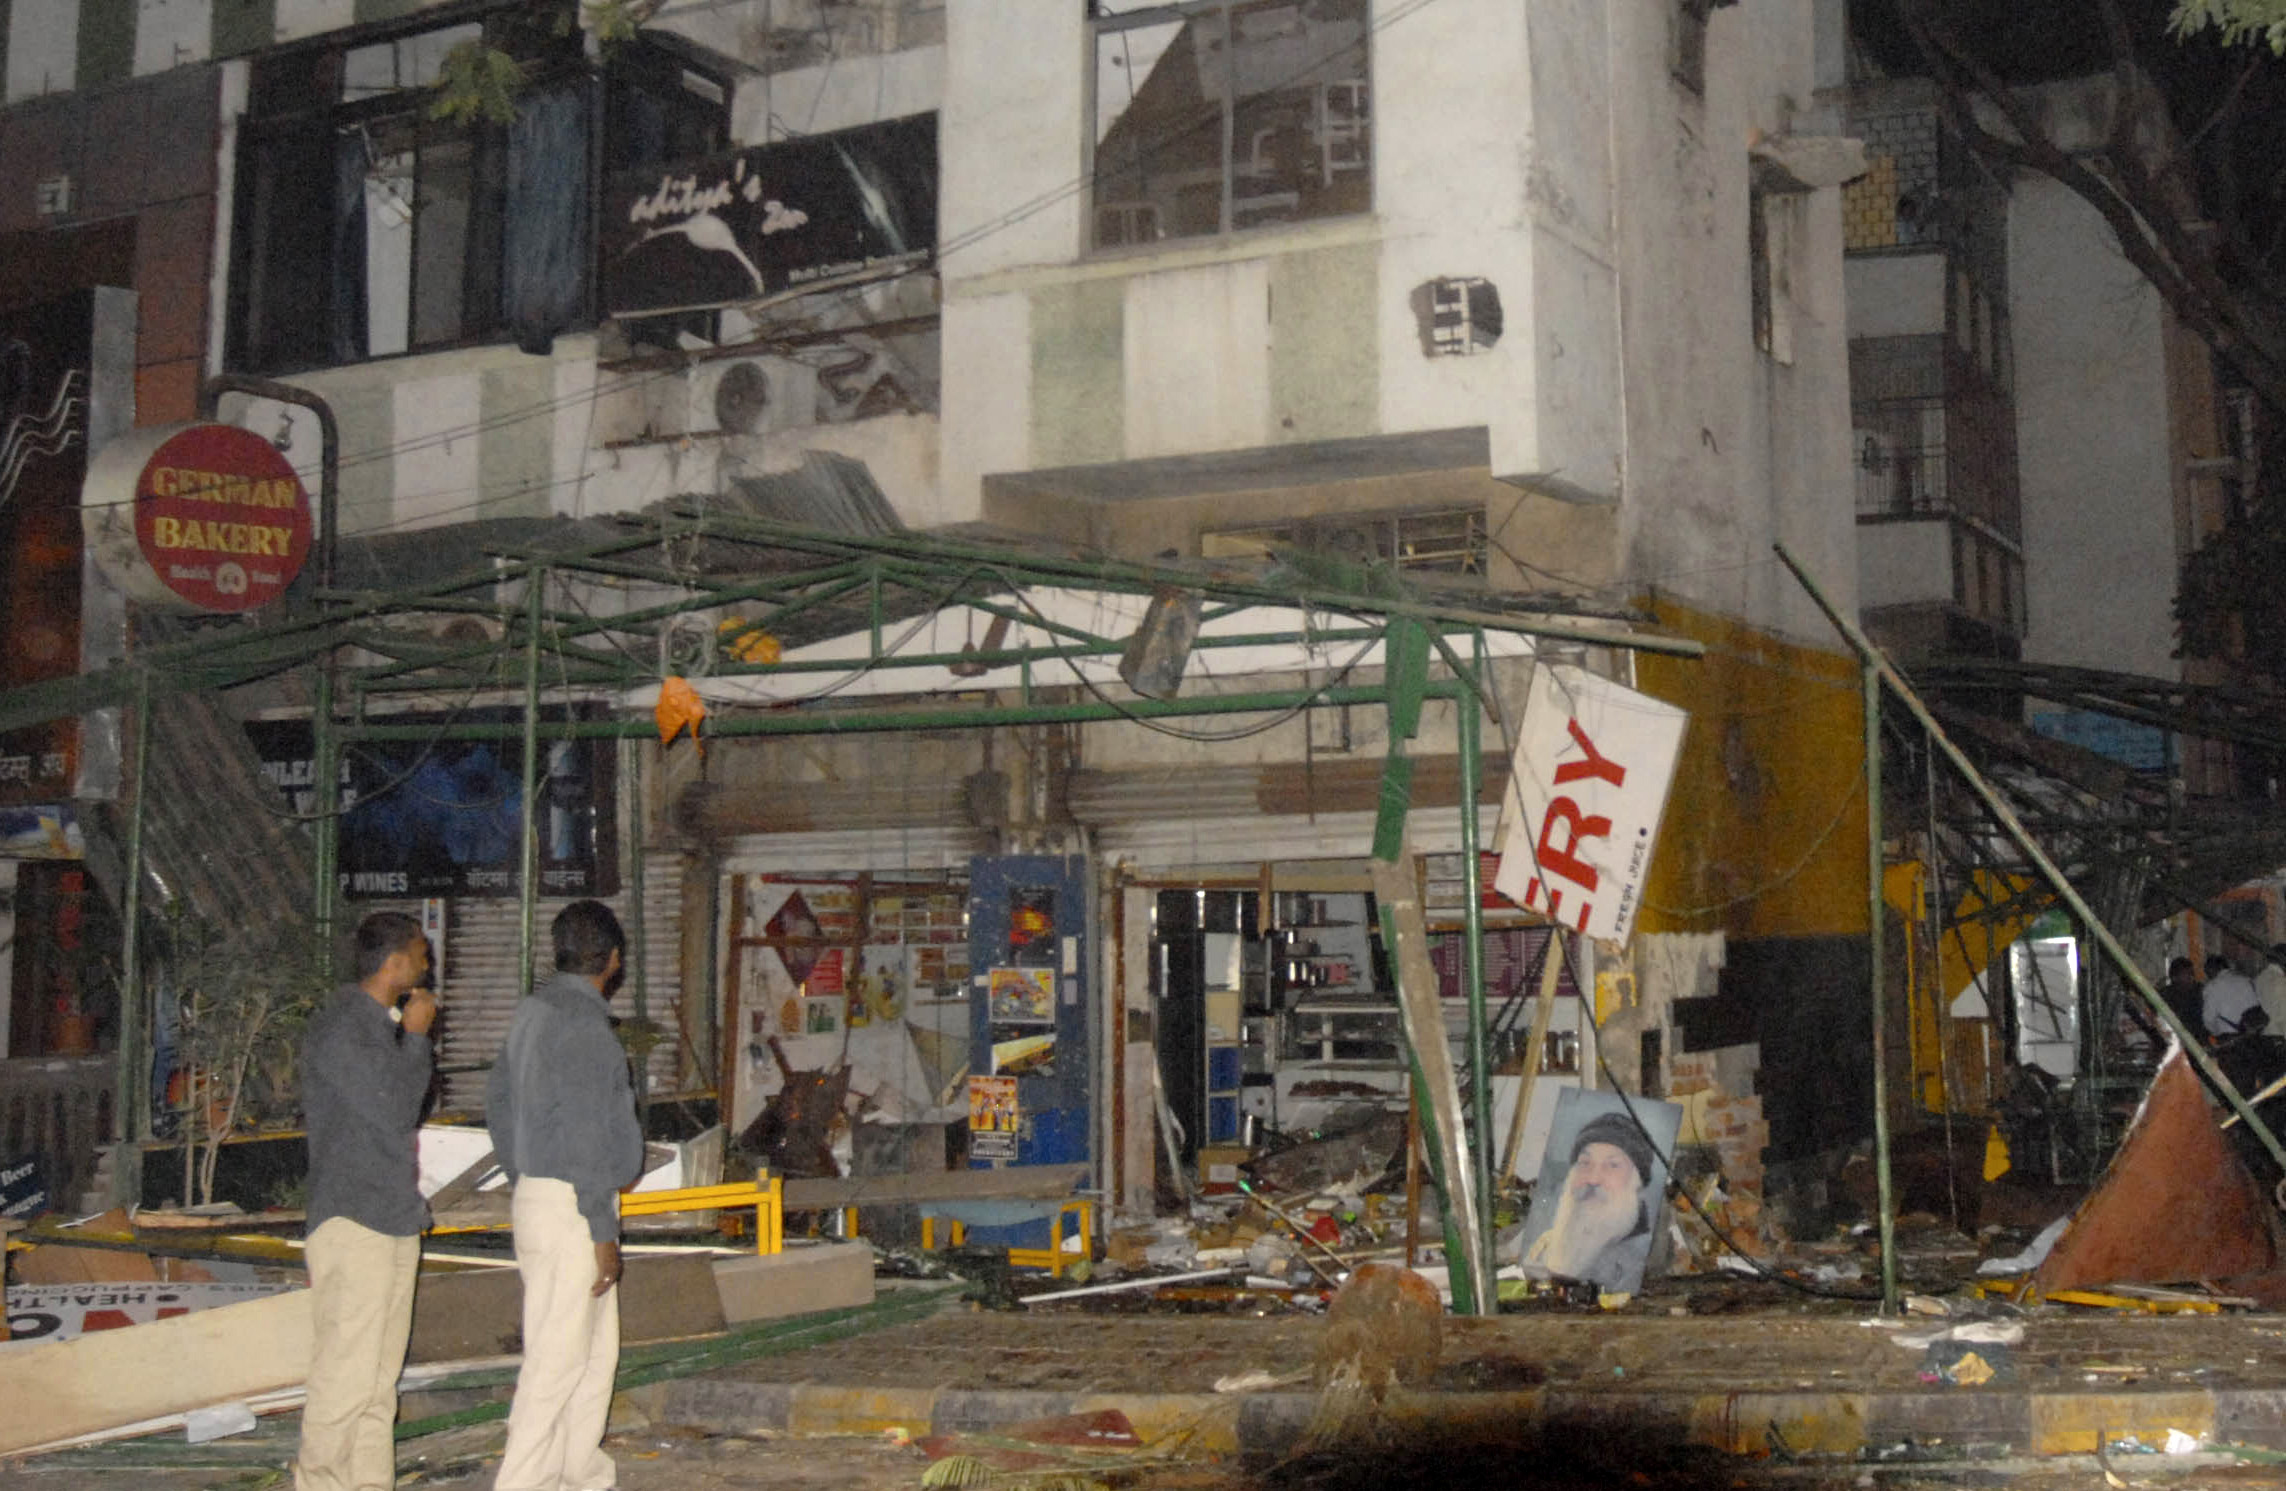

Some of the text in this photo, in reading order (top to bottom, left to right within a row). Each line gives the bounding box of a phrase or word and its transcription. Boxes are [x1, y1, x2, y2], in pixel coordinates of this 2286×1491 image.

[153, 466, 298, 508] GERMAN
[153, 515, 294, 556] BAKERY
[353, 871, 409, 893] WINES
[1, 1162, 35, 1187] Beer
